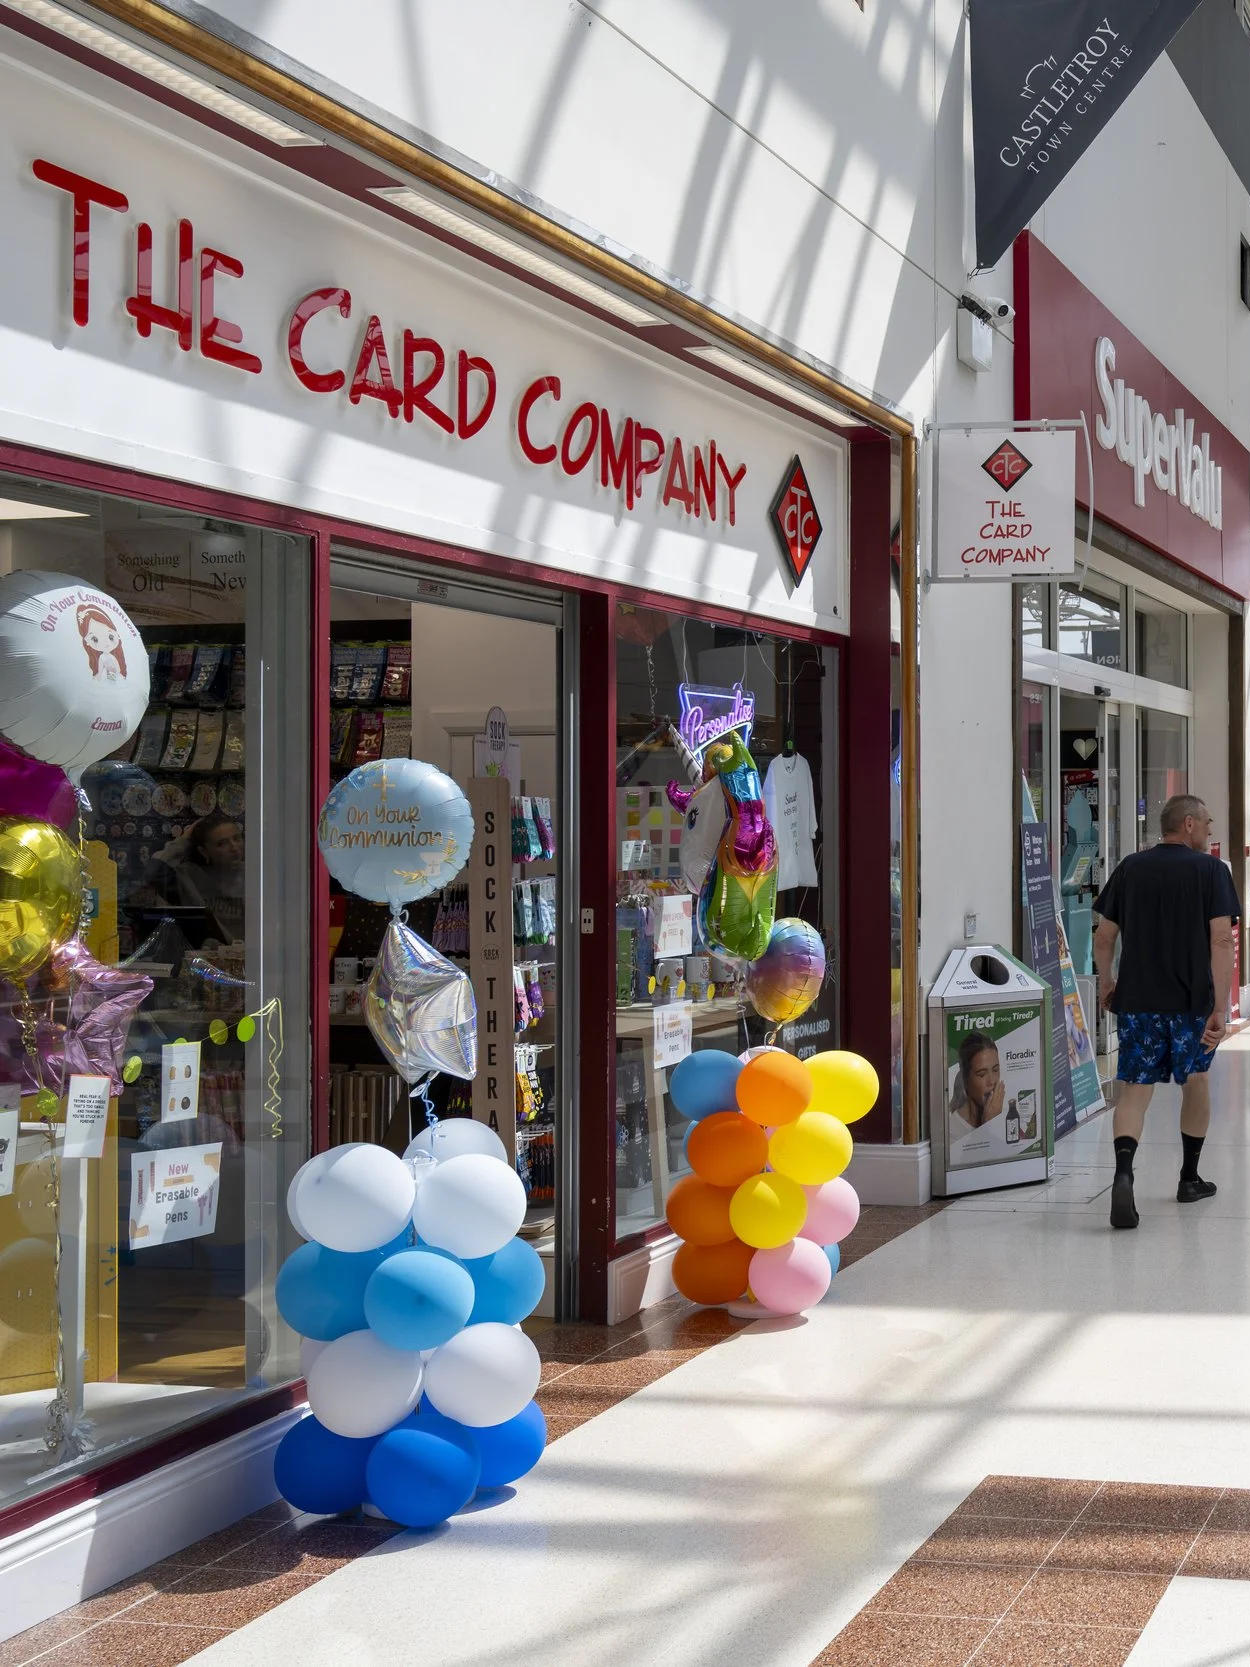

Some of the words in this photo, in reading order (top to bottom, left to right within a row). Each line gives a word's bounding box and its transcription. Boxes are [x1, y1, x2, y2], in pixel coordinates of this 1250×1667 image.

[999, 17, 1120, 168] CASTLETROY
[1027, 120, 1074, 175] TOWN
[1075, 44, 1133, 115] CENTRE
[32, 158, 263, 374] THE
[288, 286, 498, 440] CARD
[518, 375, 748, 528] COMPANY
[1096, 335, 1223, 531] SuperValu
[985, 500, 1025, 519] THE
[979, 523, 1032, 540] CARD
[117, 552, 181, 568] Something
[961, 545, 1051, 566] COMPANY
[132, 572, 164, 593] Old
[40, 613, 58, 632] On
[50, 592, 76, 613] Your
[78, 590, 137, 638] Communion
[91, 717, 122, 731] Emma
[490, 721, 506, 739] SOCK
[686, 689, 753, 750] Personalise
[490, 740, 506, 751] THERAPY
[347, 806, 369, 826] On
[375, 803, 421, 824] Your
[329, 825, 444, 849] Communion
[484, 811, 496, 933] SOCK
[483, 949, 499, 957] SOCK
[783, 1019, 830, 1042] PERSONALISED
[954, 1011, 995, 1031] Tired
[1012, 1010, 1034, 1021] Tired?
[797, 1045, 817, 1059] GIFTS
[168, 1163, 189, 1176] New
[155, 1186, 200, 1204] Erasable
[165, 1210, 189, 1224] Pens
